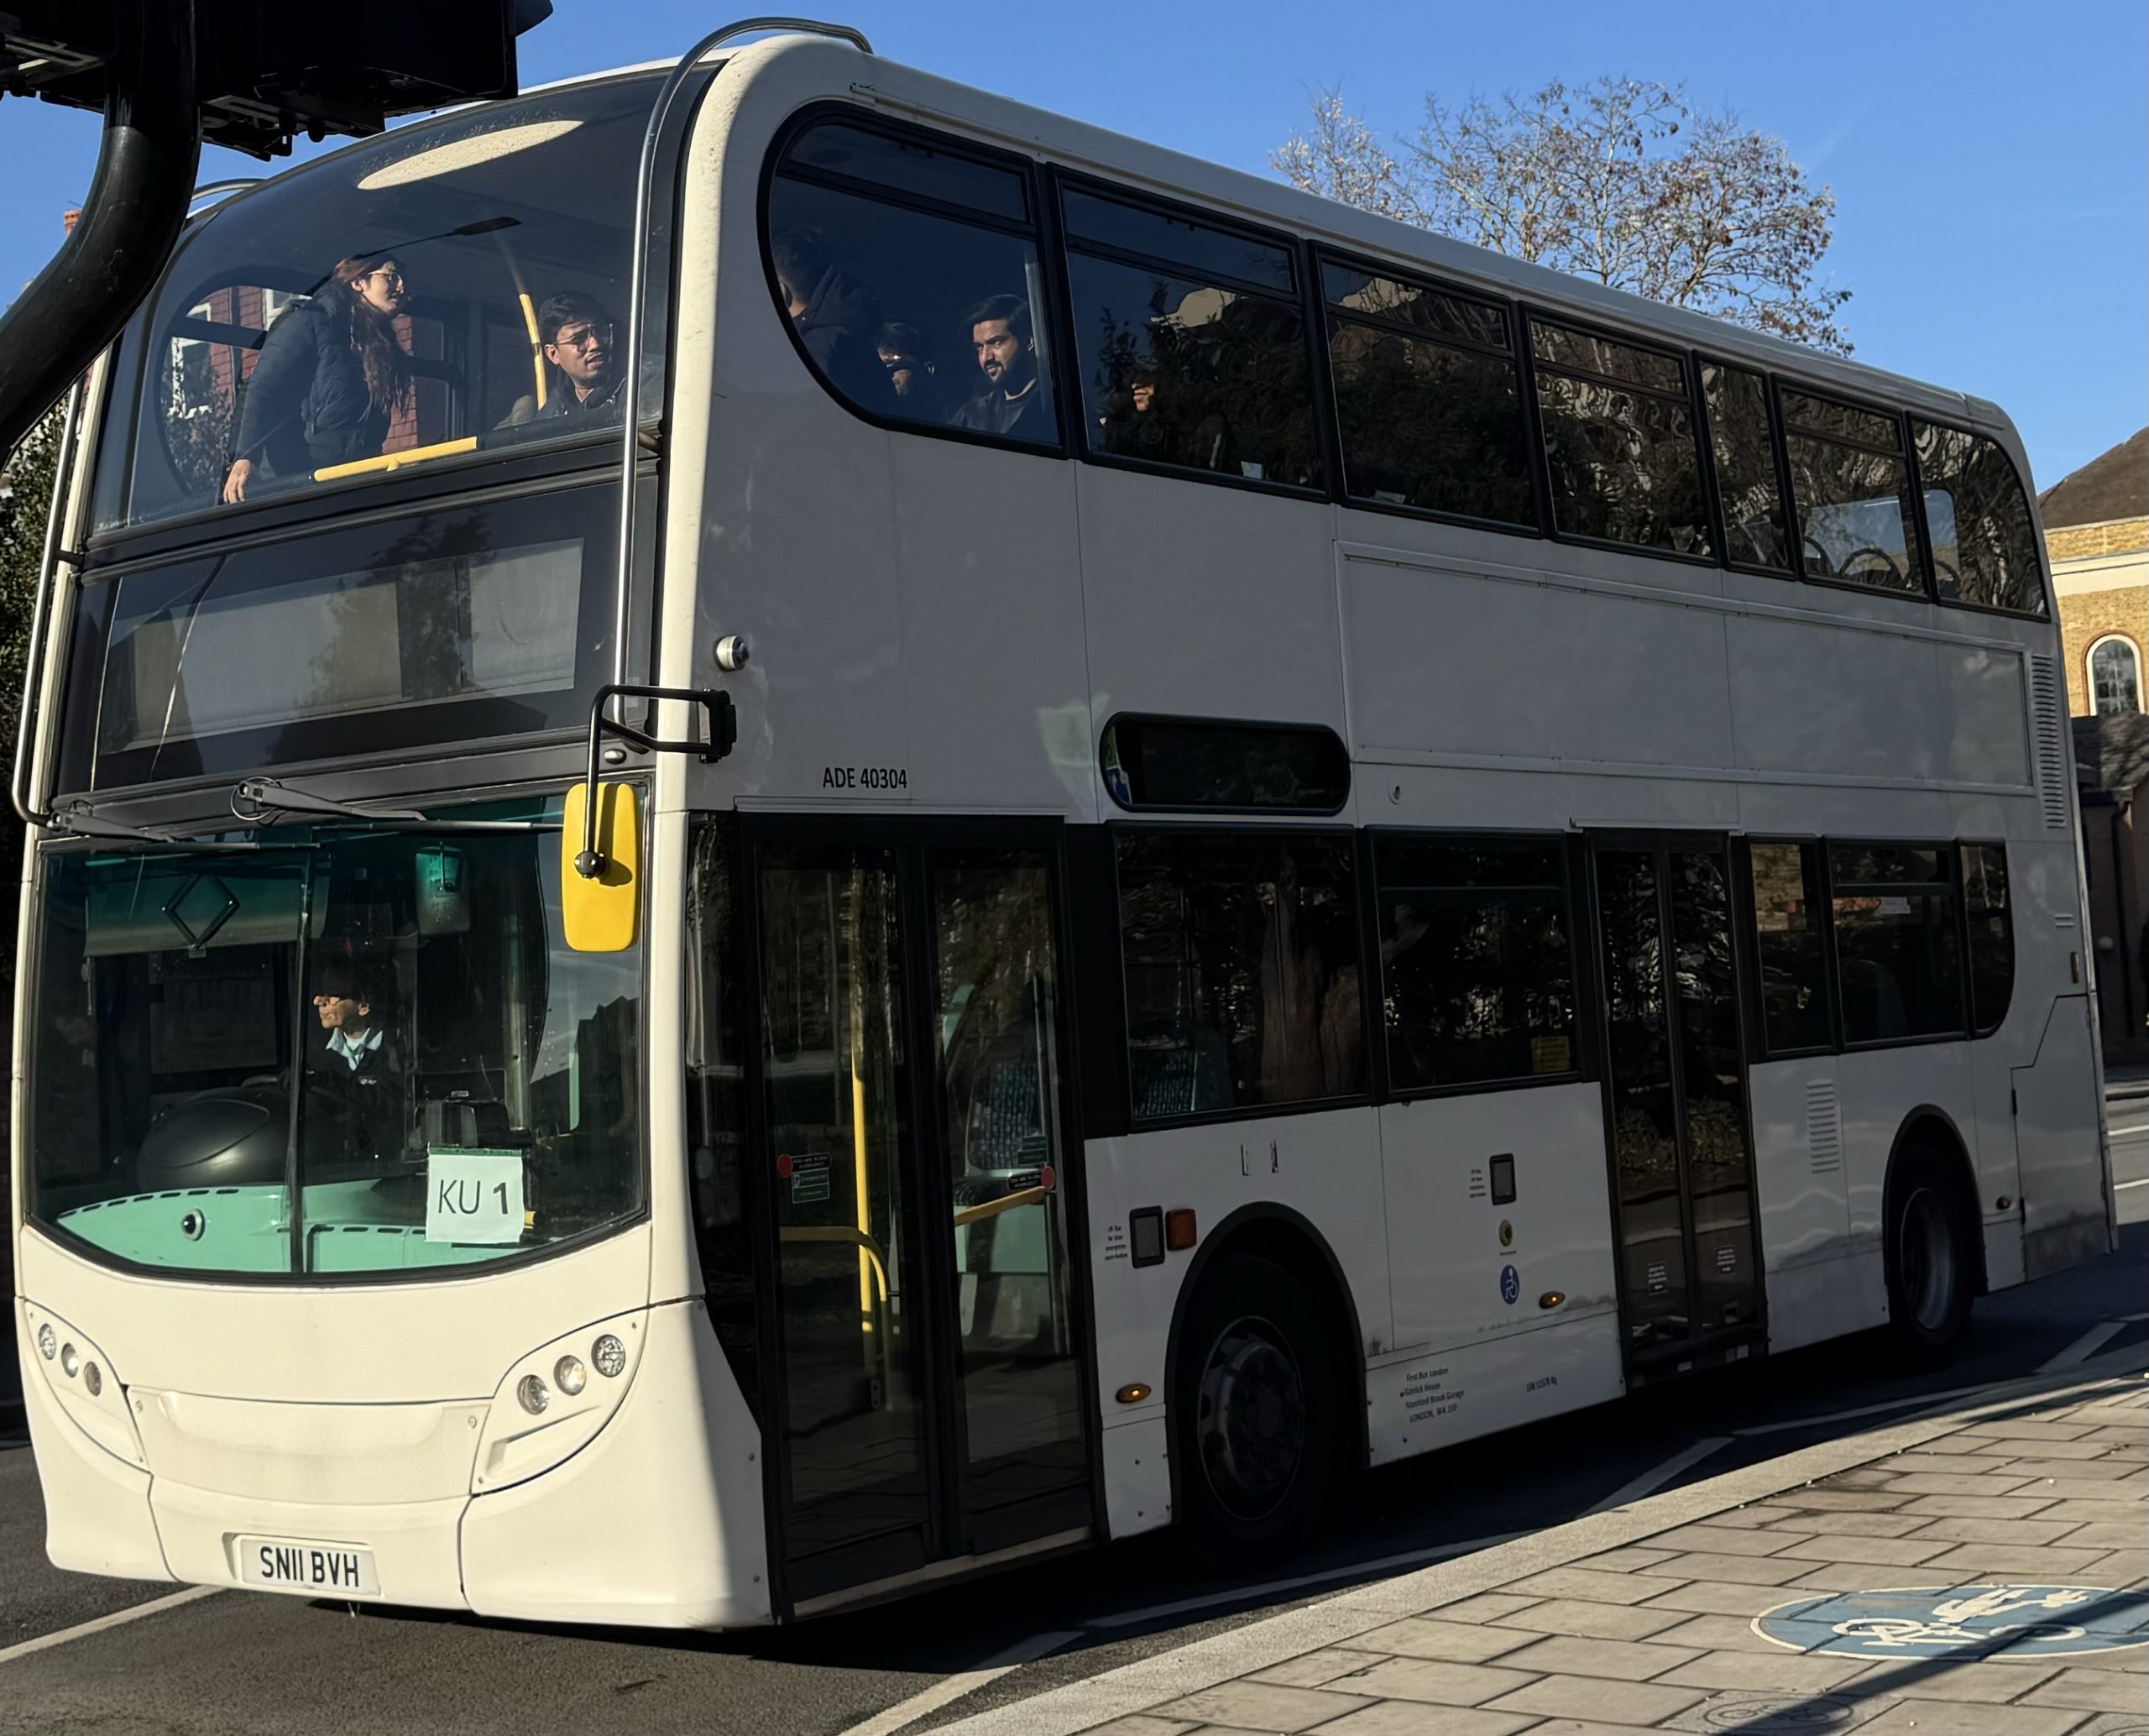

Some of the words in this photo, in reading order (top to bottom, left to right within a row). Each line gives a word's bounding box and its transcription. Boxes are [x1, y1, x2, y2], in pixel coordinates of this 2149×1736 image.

[823, 767, 856, 788] ADE
[860, 767, 907, 789] 40304
[438, 1179, 481, 1215] KU
[493, 1182, 509, 1216] 1
[259, 1545, 304, 1582] SN11
[311, 1550, 359, 1587] BVH
